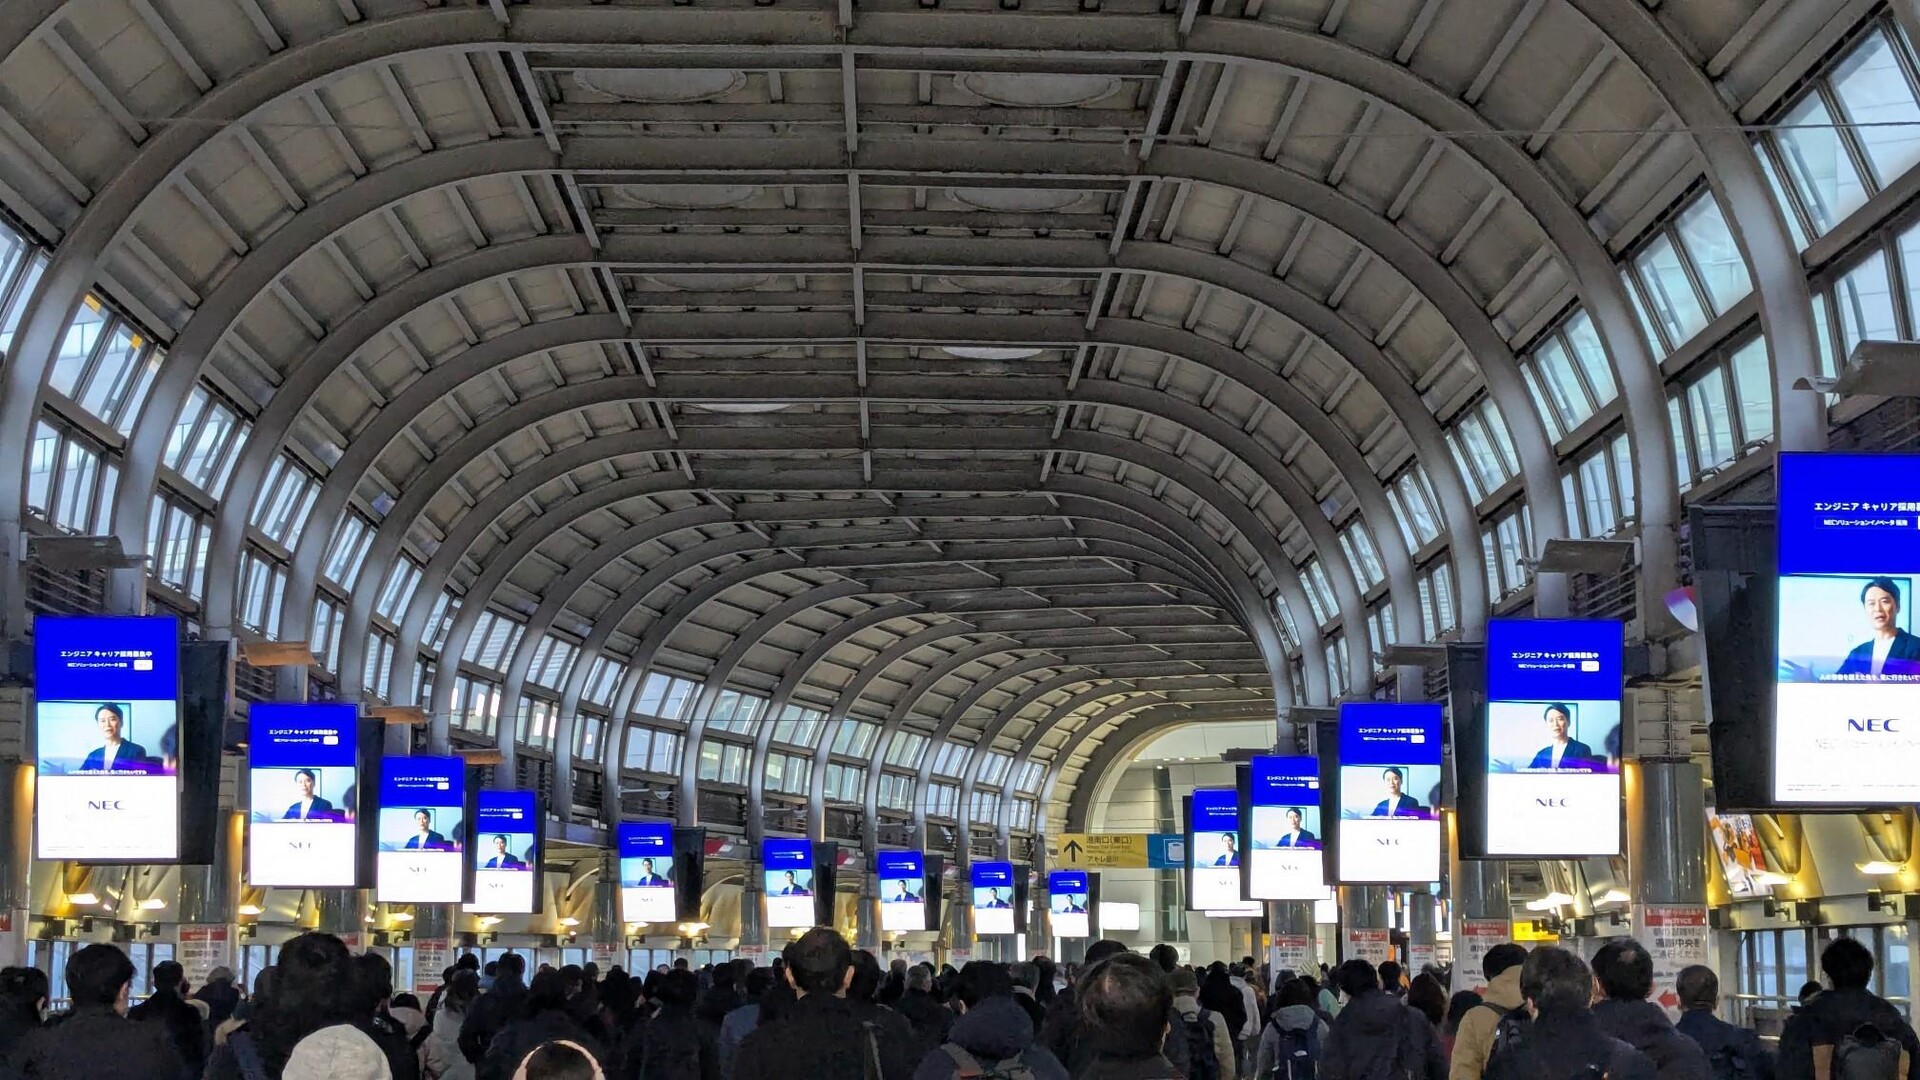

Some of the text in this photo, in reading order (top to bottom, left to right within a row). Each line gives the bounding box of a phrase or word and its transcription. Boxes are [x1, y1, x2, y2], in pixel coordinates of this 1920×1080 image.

[1814, 502, 1859, 511] エンジニア
[1847, 718, 1900, 732] NEC
[88, 800, 126, 810] NEC
[1535, 798, 1571, 808] NEC
